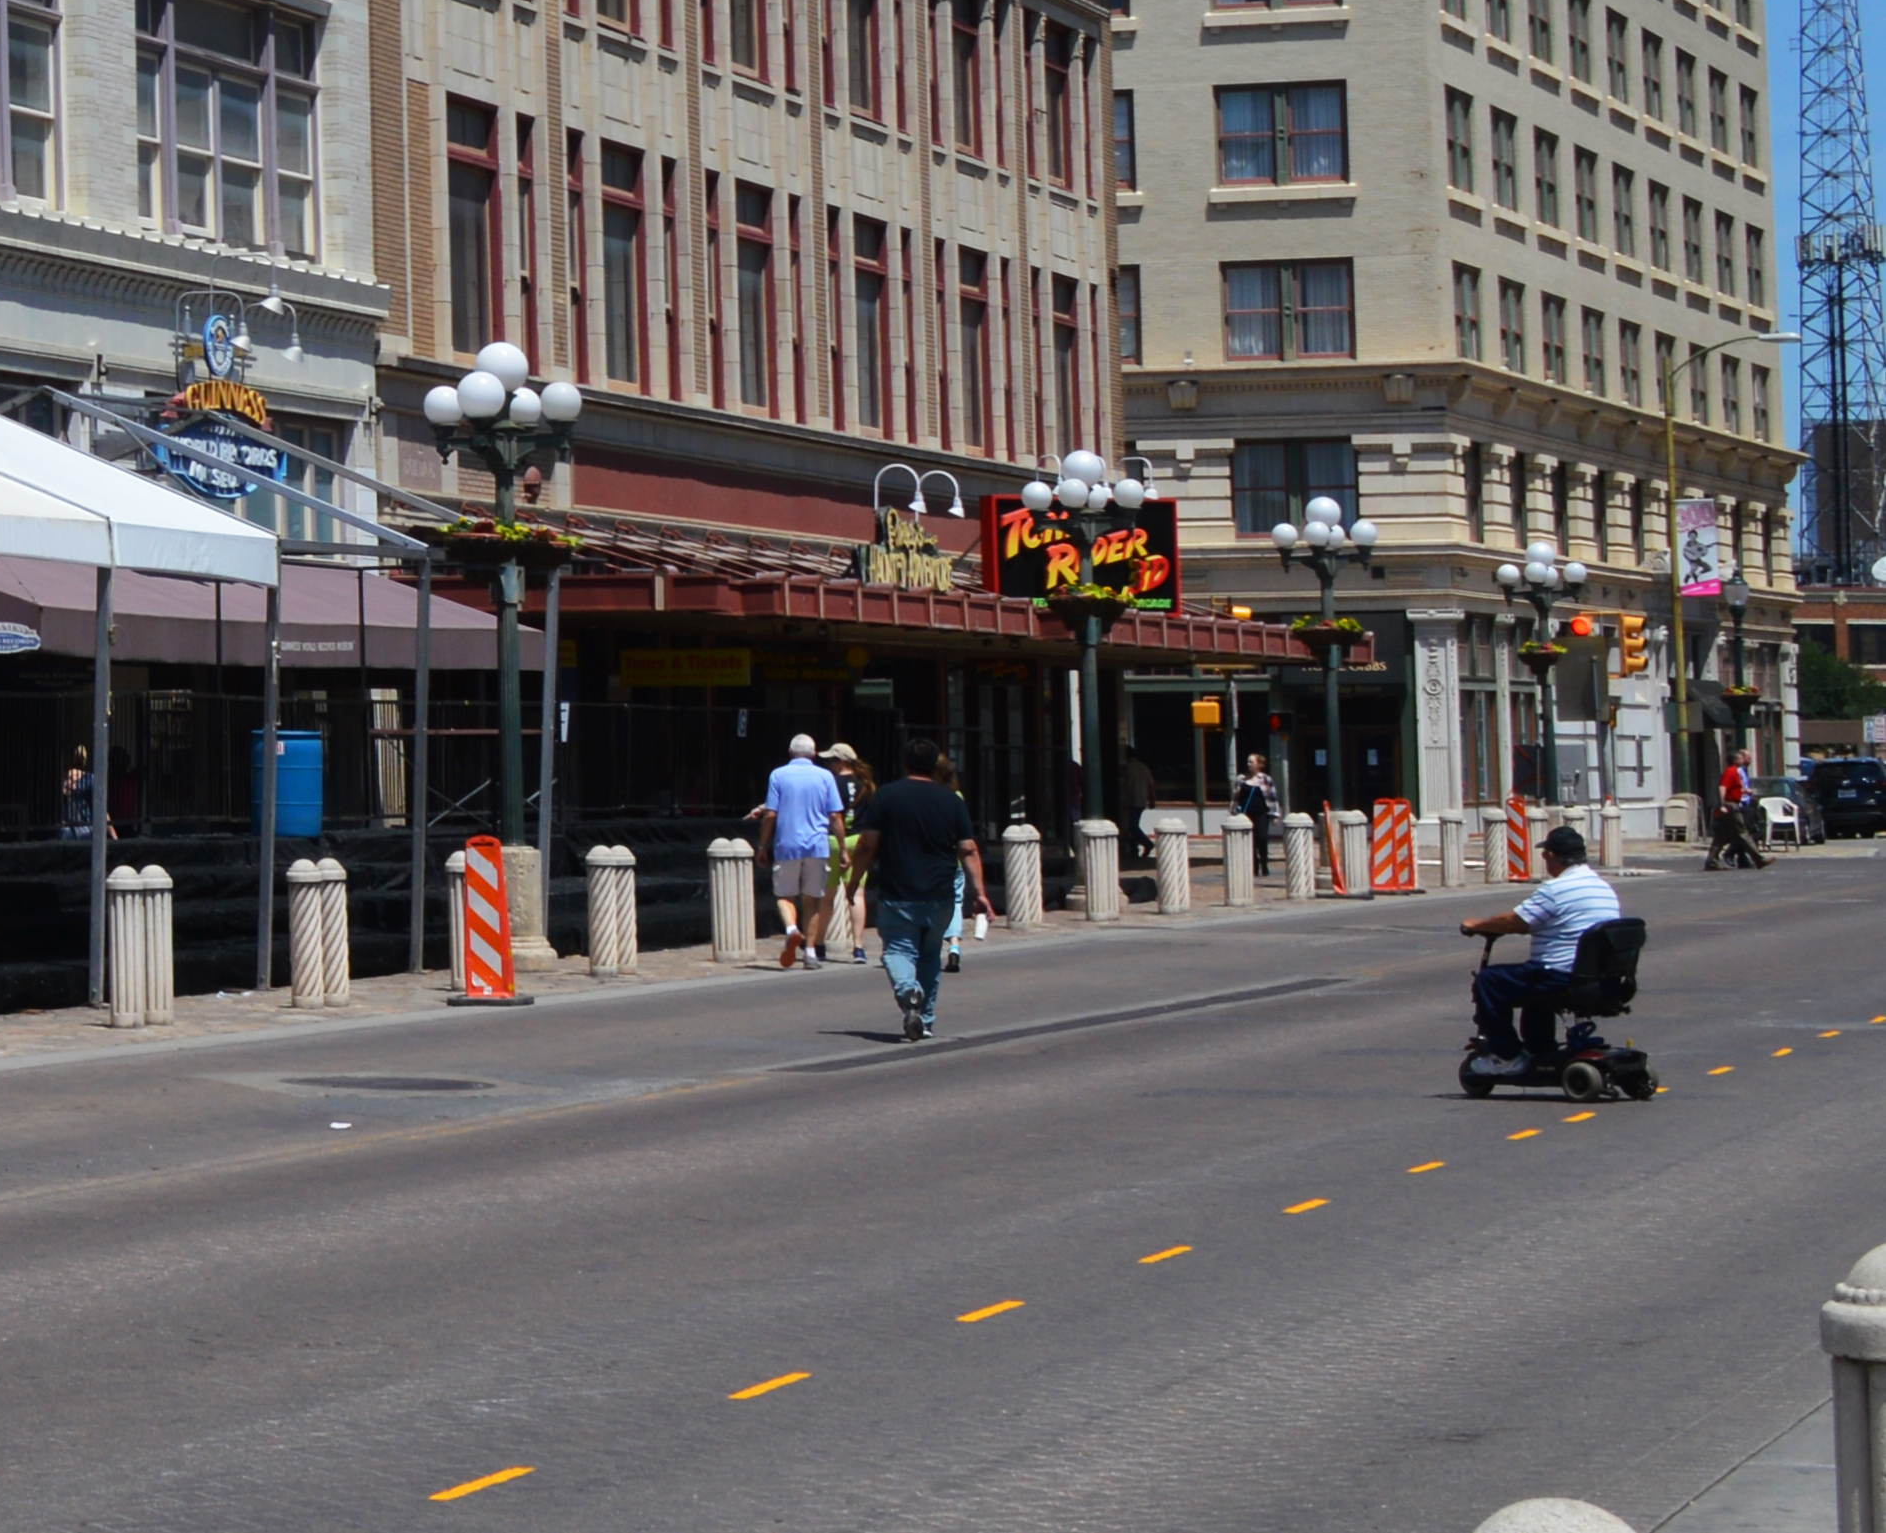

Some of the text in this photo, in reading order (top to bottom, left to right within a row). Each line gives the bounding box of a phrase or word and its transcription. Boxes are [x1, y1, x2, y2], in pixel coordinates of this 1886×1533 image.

[186, 380, 267, 425] GUINNESS
[1046, 528, 1149, 590] RDER
[1136, 598, 1173, 608] RCADE
[625, 655, 666, 670] Tours
[687, 655, 744, 670] Tickets
